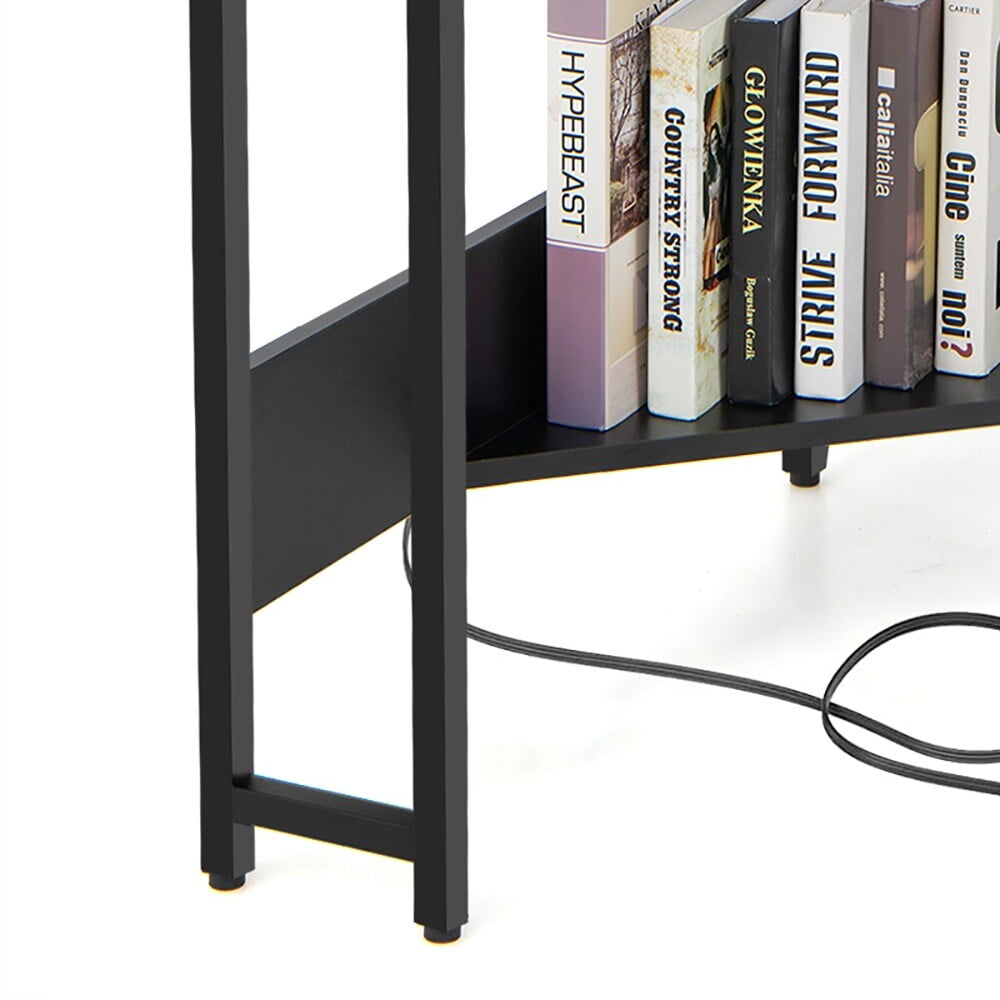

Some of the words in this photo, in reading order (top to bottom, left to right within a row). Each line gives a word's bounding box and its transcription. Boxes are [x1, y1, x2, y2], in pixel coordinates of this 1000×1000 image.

[948, 4, 981, 16] CARTIER
[959, 50, 970, 74] Dan
[561, 50, 585, 234] HYPEBEAST
[802, 51, 840, 221] FORWARD
[957, 78, 969, 138] Dungaciu
[663, 107, 686, 229] COUNTRY
[876, 92, 895, 198] caliaitalia
[944, 151, 977, 222] Cine
[662, 230, 684, 333] STRONG
[954, 233, 966, 281] suntem
[744, 328, 756, 361] Guzik
[800, 250, 836, 368] STRIVE
[940, 289, 974, 359] noi?
